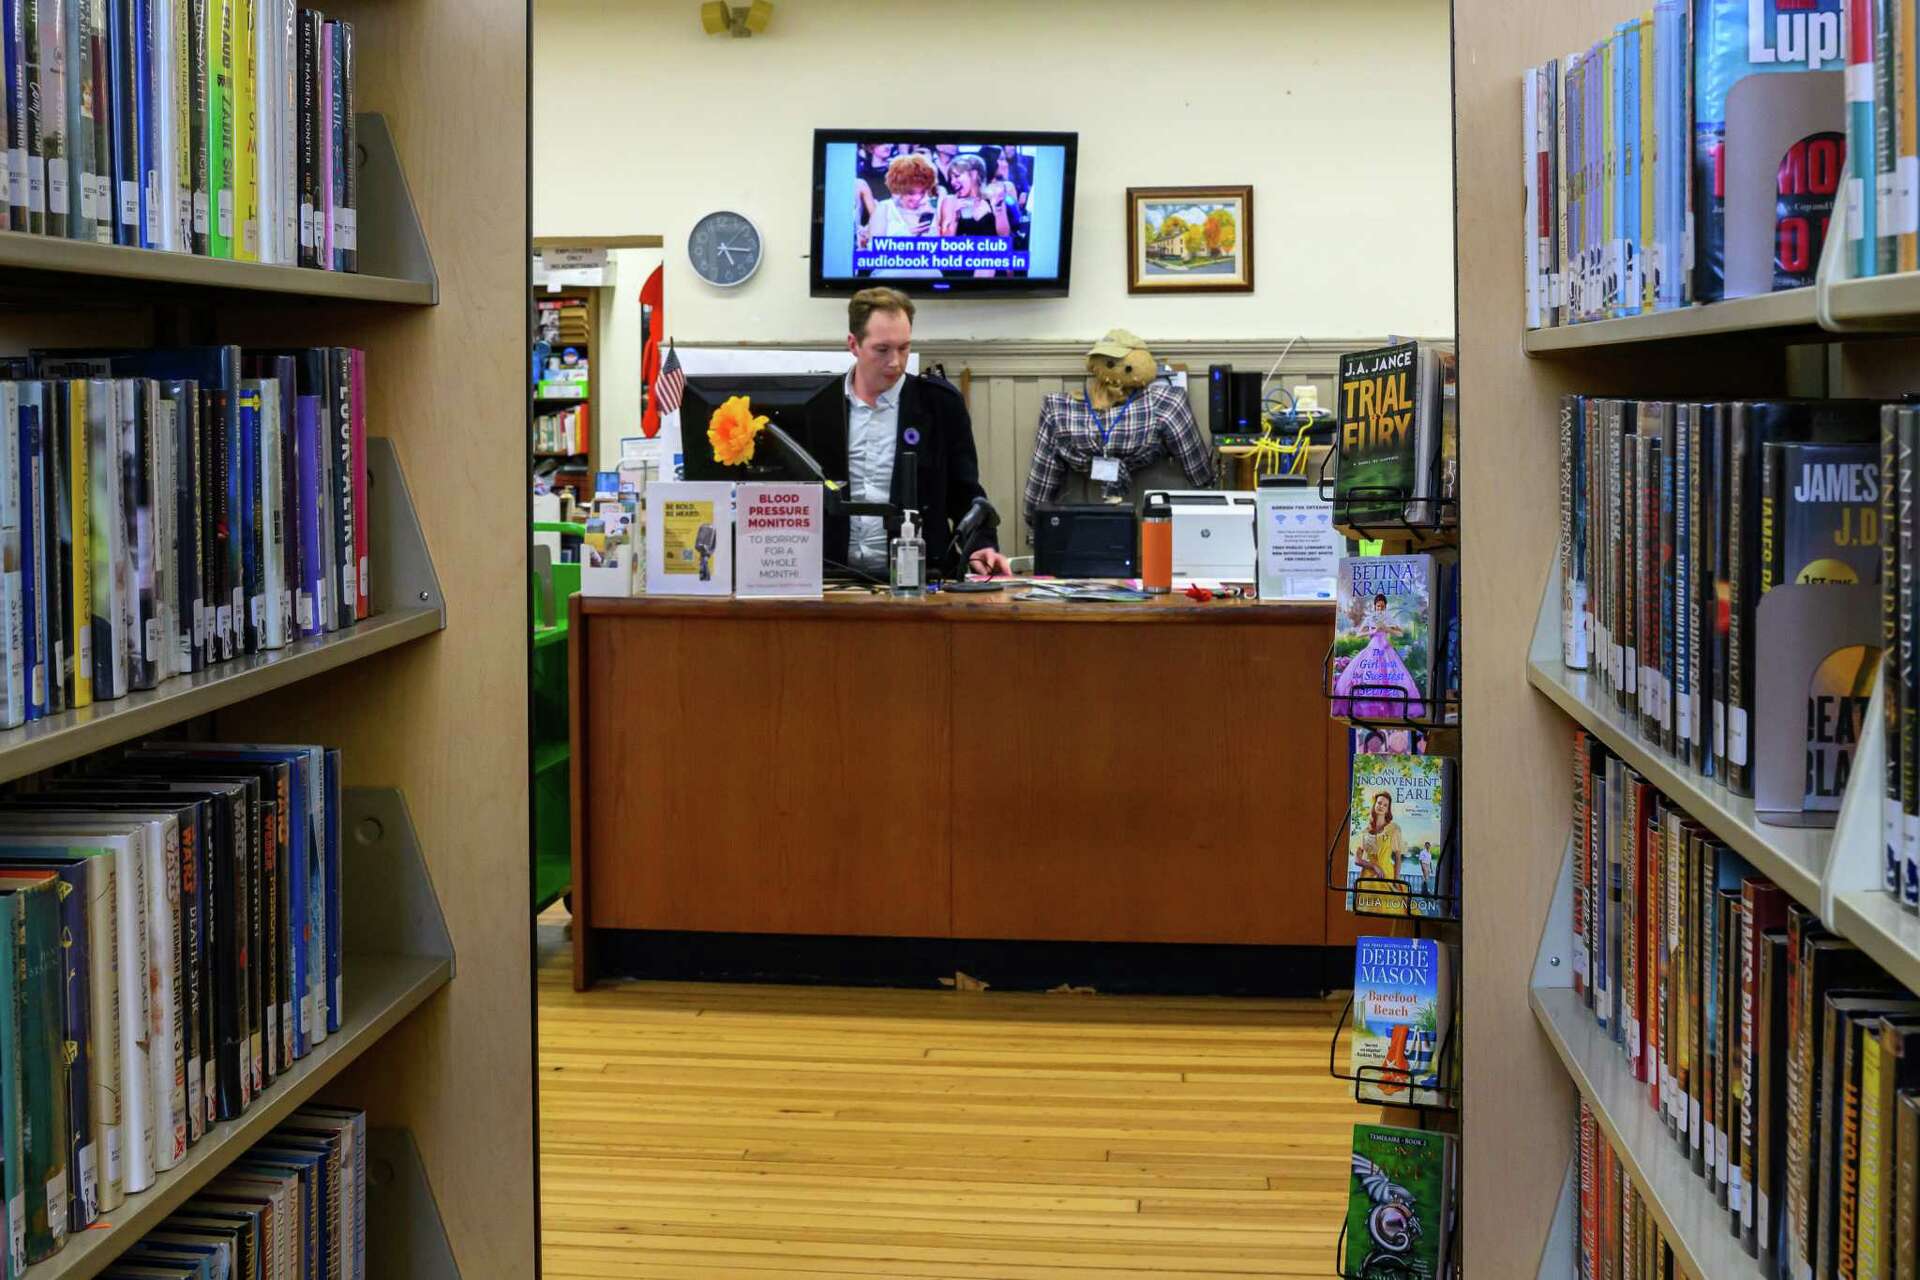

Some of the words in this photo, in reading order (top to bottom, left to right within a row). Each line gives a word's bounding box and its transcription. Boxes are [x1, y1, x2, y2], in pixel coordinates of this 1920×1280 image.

[874, 239, 914, 251] When
[917, 241, 938, 254] my
[941, 239, 974, 251] book
[977, 239, 1007, 251] club
[857, 254, 929, 268] audiobook
[932, 255, 962, 268] hold
[965, 257, 1010, 268] comes
[1013, 255, 1025, 268] in
[1345, 362, 1369, 377] J.A.
[1371, 352, 1412, 373] JANCE
[1343, 372, 1413, 419] TRIAL
[1343, 413, 1412, 451] FURY
[1794, 463, 1879, 502] JAMES
[759, 494, 800, 504] BLOOD
[1899, 441, 1912, 550] ANNE
[749, 506, 810, 516] PRESSURE
[748, 518, 811, 528] MONITORS
[750, 535, 763, 545] TO
[765, 535, 811, 545] BORROW
[764, 547, 785, 555] FOR
[787, 547, 794, 555] A
[760, 558, 798, 567] WHOLE
[759, 569, 800, 579] MONTH!
[1352, 564, 1413, 581] BETINA
[1352, 580, 1412, 597] KRAHN
[1900, 564, 1913, 687] PERRY
[1359, 659, 1379, 670] Girl
[1382, 768, 1395, 777] AN
[1357, 776, 1440, 788] INCONVENIENT
[1396, 787, 1433, 804] EARL
[137, 863, 146, 942] WINTER
[190, 905, 198, 964] DEATH
[1742, 900, 1753, 984] JAMES
[1361, 948, 1429, 969] DEBBIE
[1361, 966, 1428, 986] MASON
[140, 950, 149, 1020] PALACE
[1369, 990, 1418, 1004] Barefoot
[173, 975, 184, 1051] EMPIRE'S
[1374, 1004, 1409, 1017] Beach
[175, 1055, 185, 1086] END
[1742, 990, 1753, 1146] PATTERSON
[1842, 1082, 1858, 1161] JAMES
